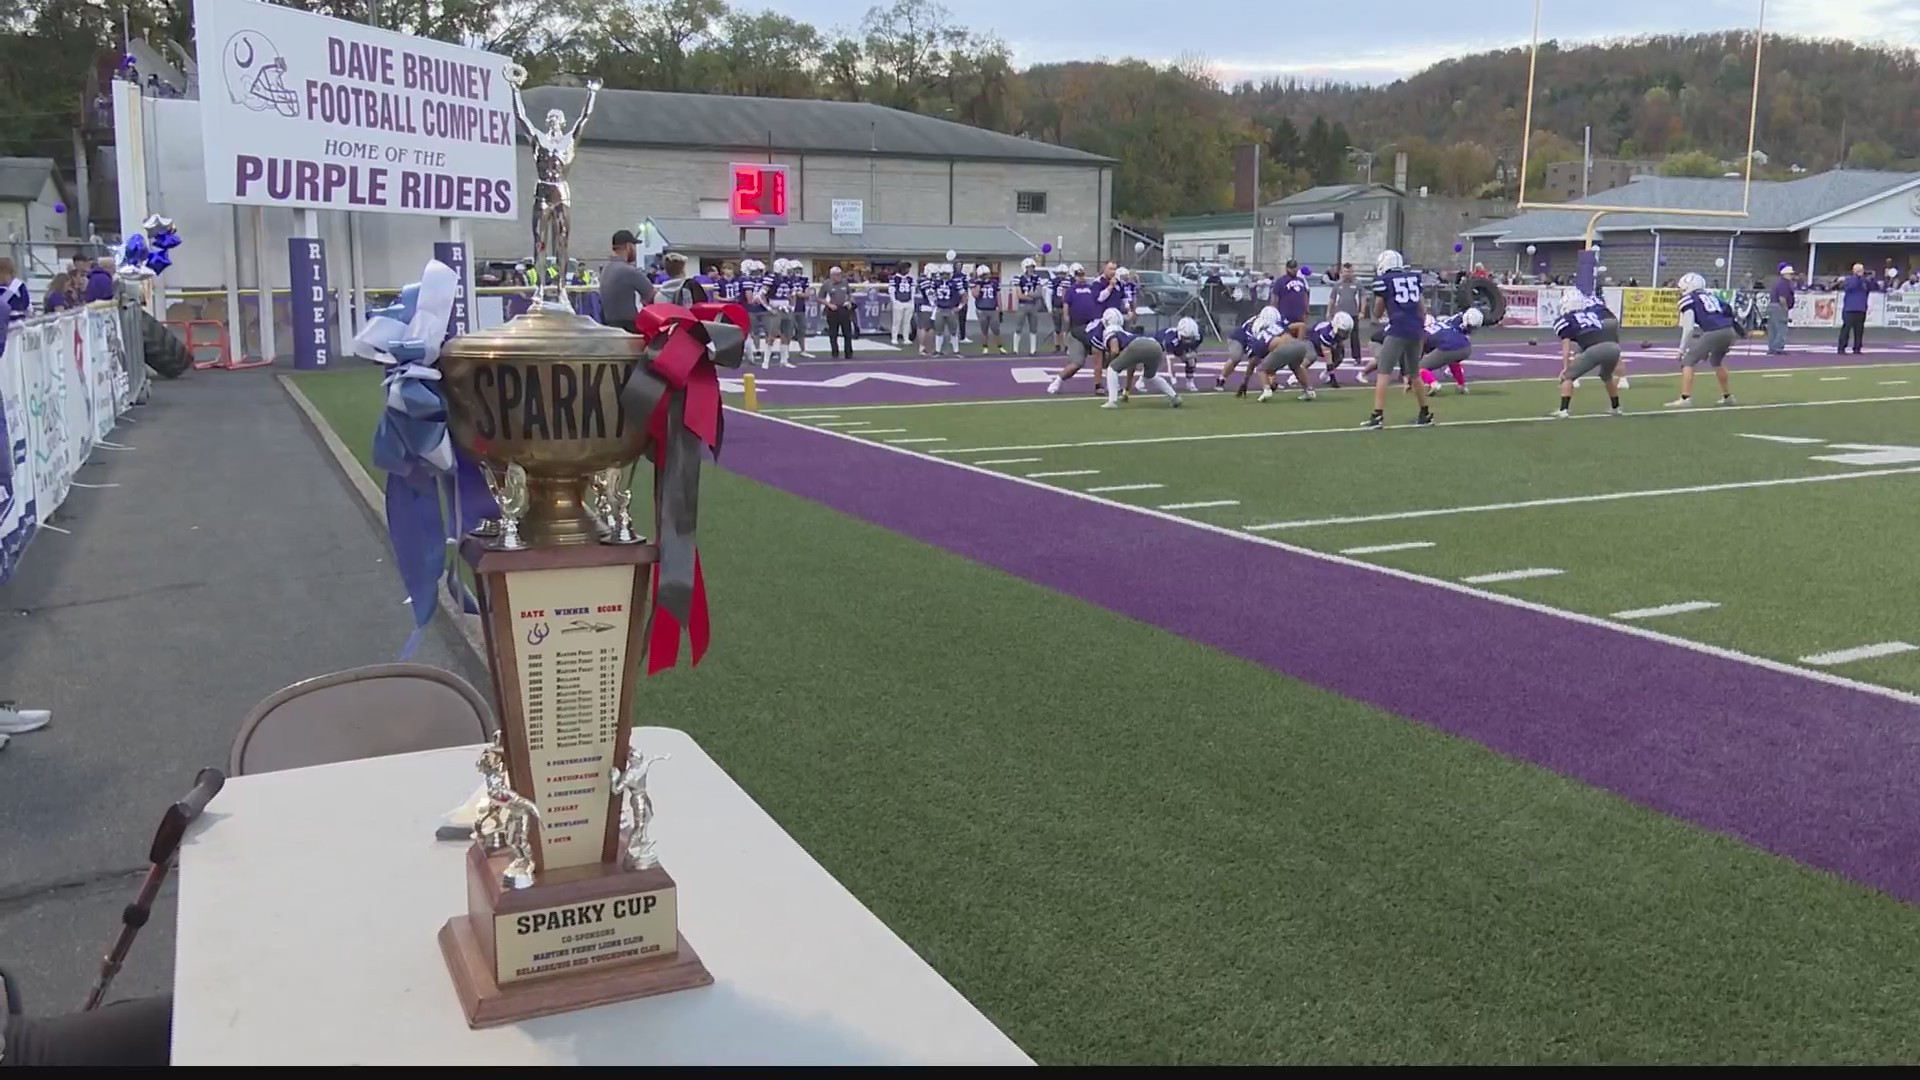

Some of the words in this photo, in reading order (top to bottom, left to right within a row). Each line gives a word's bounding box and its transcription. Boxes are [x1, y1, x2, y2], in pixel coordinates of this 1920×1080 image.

[328, 36, 395, 85] DAVE
[402, 52, 492, 101] BRUNEY
[306, 79, 416, 134] FOOTBALL
[422, 99, 512, 146] COMPLEX
[325, 140, 379, 160] HOME
[385, 146, 408, 162] OF
[414, 150, 446, 166] THE
[236, 154, 388, 206] PURPLE
[401, 170, 512, 214] RIDERS
[735, 169, 784, 214] 21
[308, 243, 327, 364] RIDERS
[1392, 276, 1420, 304] 55
[864, 306, 880, 317] 70
[474, 363, 635, 440] SPARKY
[520, 610, 545, 618] DATE
[554, 607, 590, 616] WINNER
[597, 604, 623, 613] SCORE
[517, 902, 606, 935] SPARKY
[614, 895, 657, 919] CUP
[533, 948, 569, 961] MARTINS
[571, 945, 596, 955] FERRY
[598, 940, 622, 950] LIONS
[623, 936, 644, 946] CLUB
[562, 928, 616, 943] CO-SPONSORS
[590, 948, 639, 963] TOUCHDOWN
[640, 944, 661, 954] CLUB
